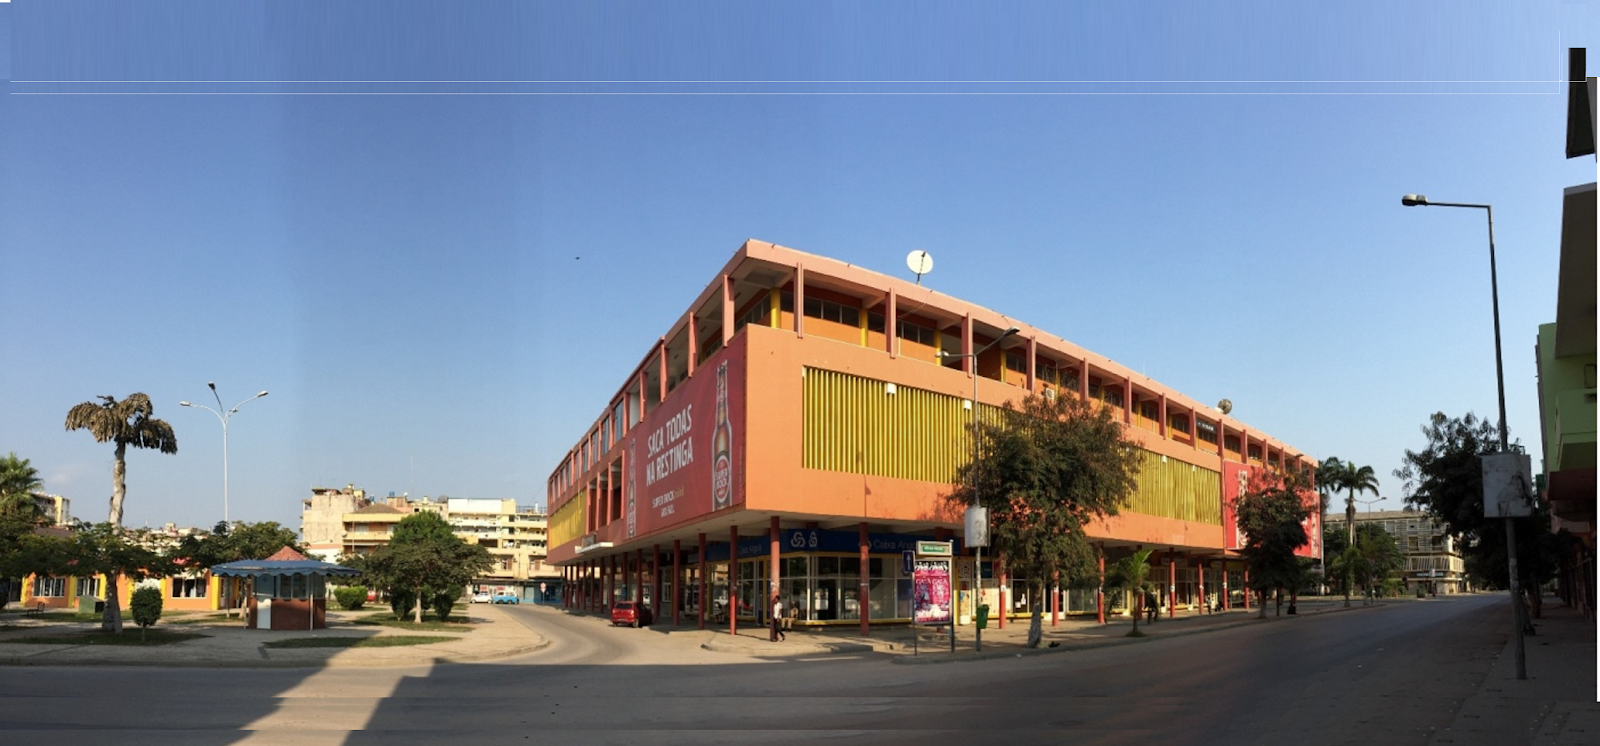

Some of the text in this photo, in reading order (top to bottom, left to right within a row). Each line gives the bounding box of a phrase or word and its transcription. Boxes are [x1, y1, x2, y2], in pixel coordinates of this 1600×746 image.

[648, 403, 692, 459] SACA TODAS
[646, 436, 694, 487] NA RESTINGA
[873, 539, 896, 550] Caixa
